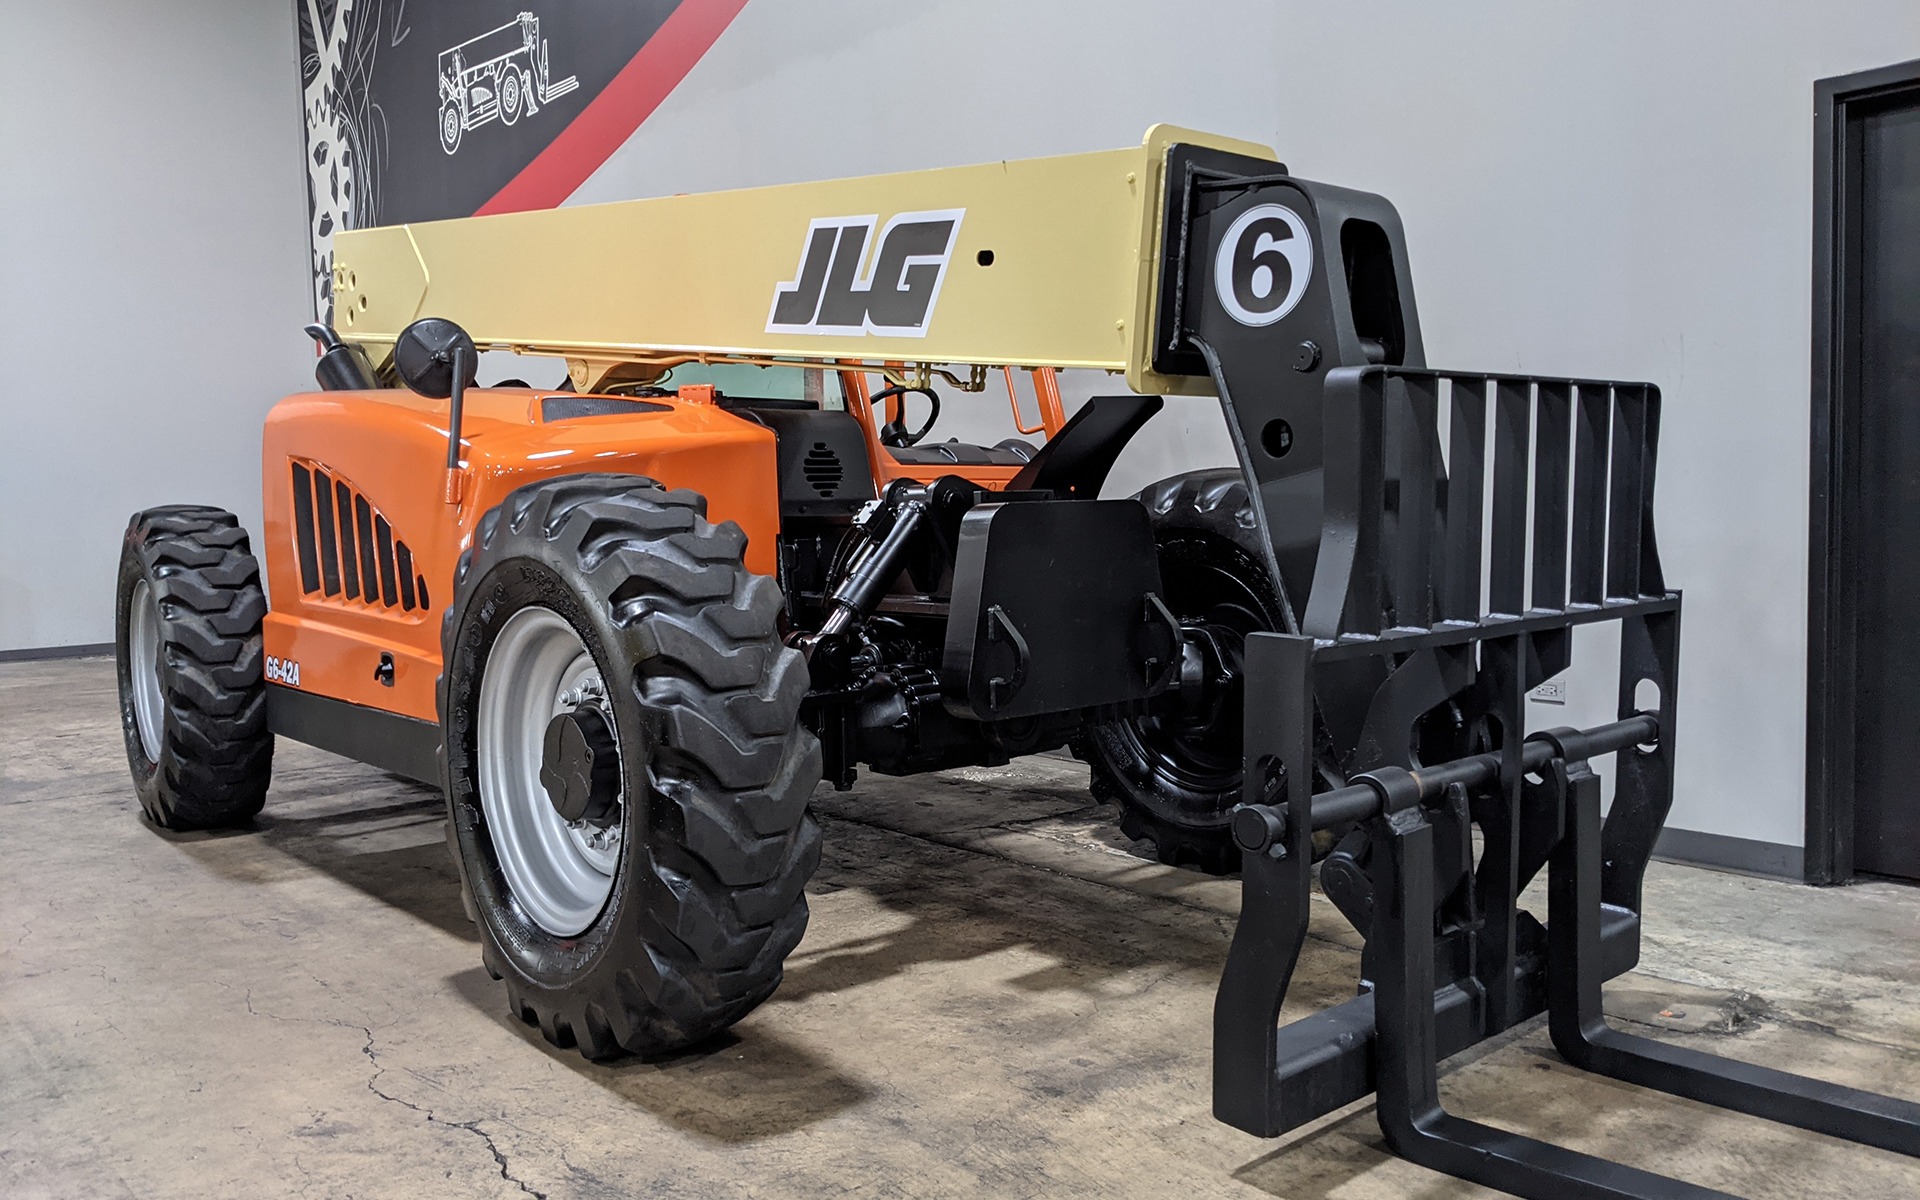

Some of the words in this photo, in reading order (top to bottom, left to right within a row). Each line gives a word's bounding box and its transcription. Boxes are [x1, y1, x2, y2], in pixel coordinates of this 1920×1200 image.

[769, 216, 959, 331] JLG
[1232, 217, 1294, 314] 6
[266, 655, 300, 687] G6-42A
